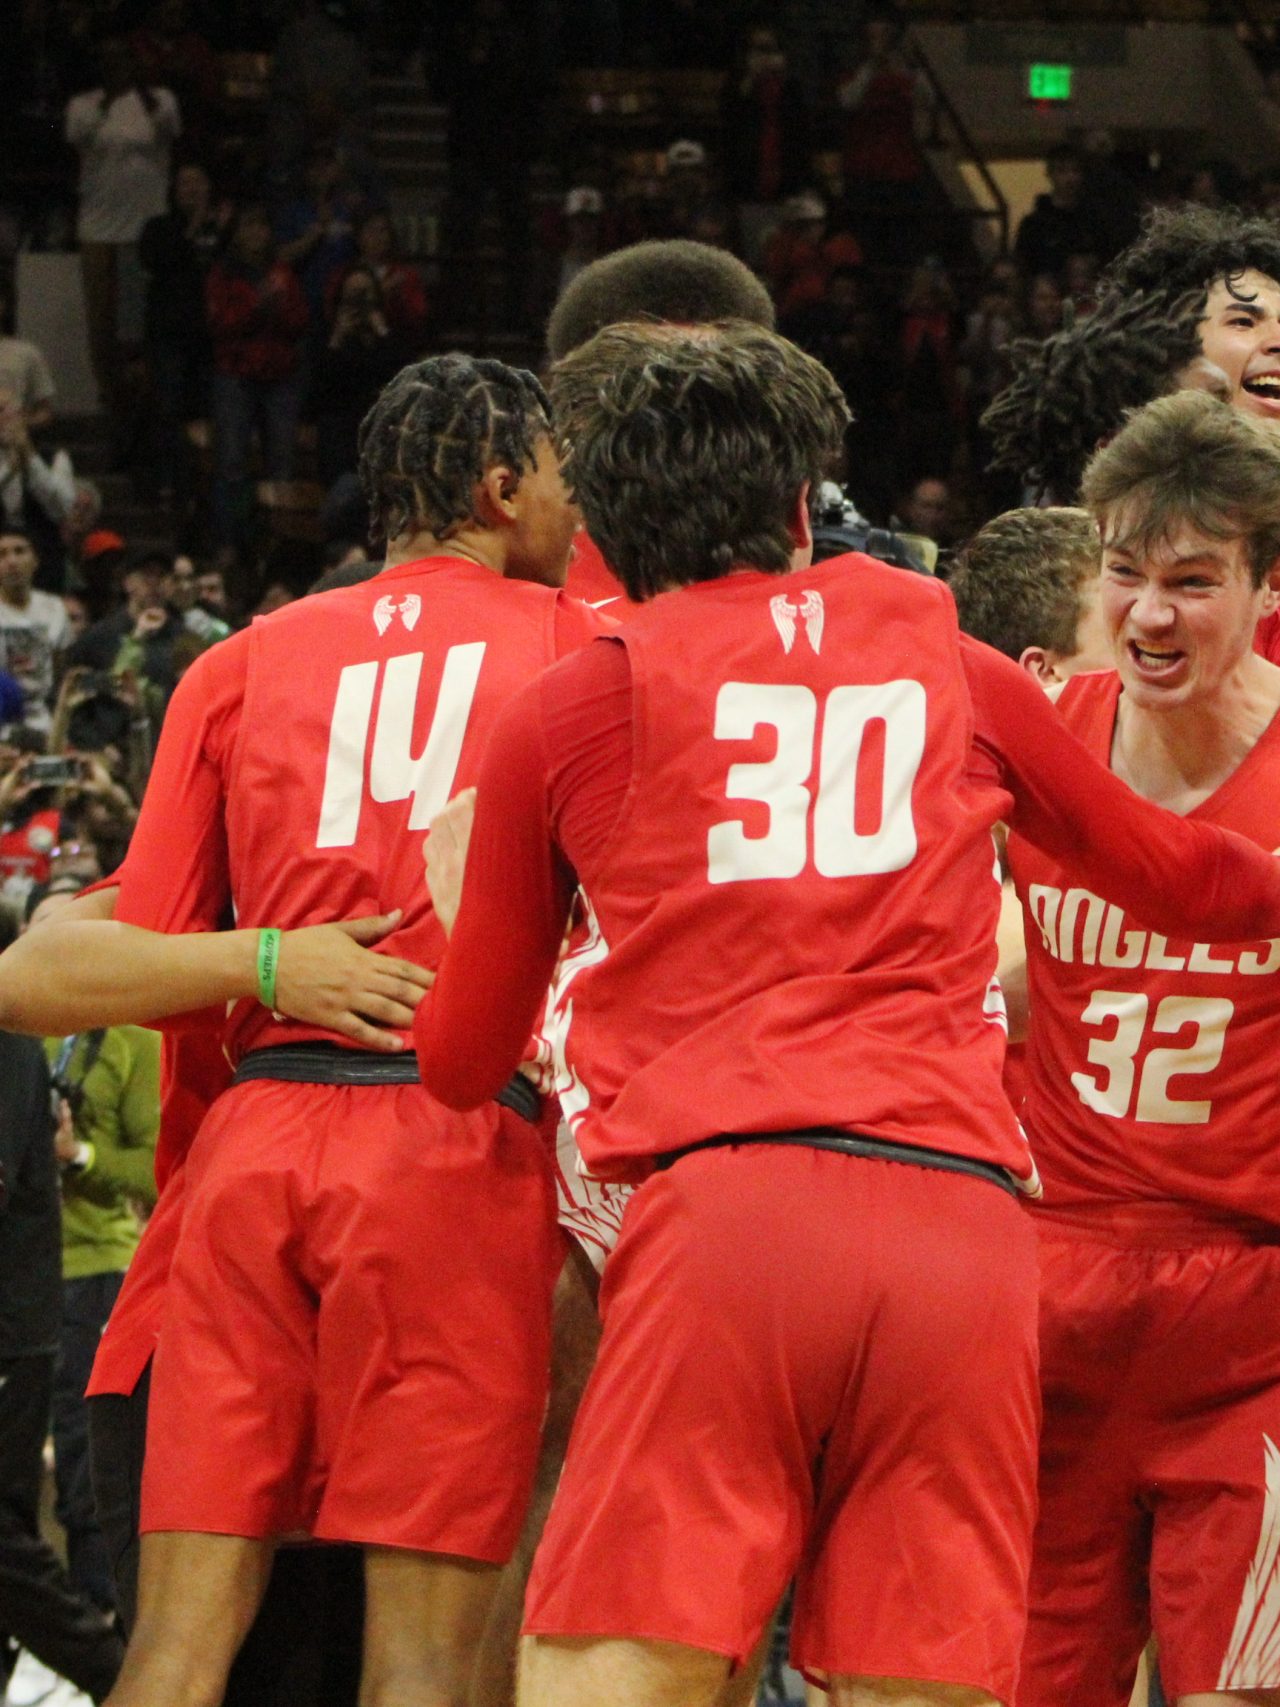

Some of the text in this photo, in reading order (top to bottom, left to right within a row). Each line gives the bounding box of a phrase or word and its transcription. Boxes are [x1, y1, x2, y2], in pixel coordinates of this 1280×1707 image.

[316, 641, 486, 849] 14
[707, 679, 927, 884] 30
[1070, 989, 1235, 1124] 32
